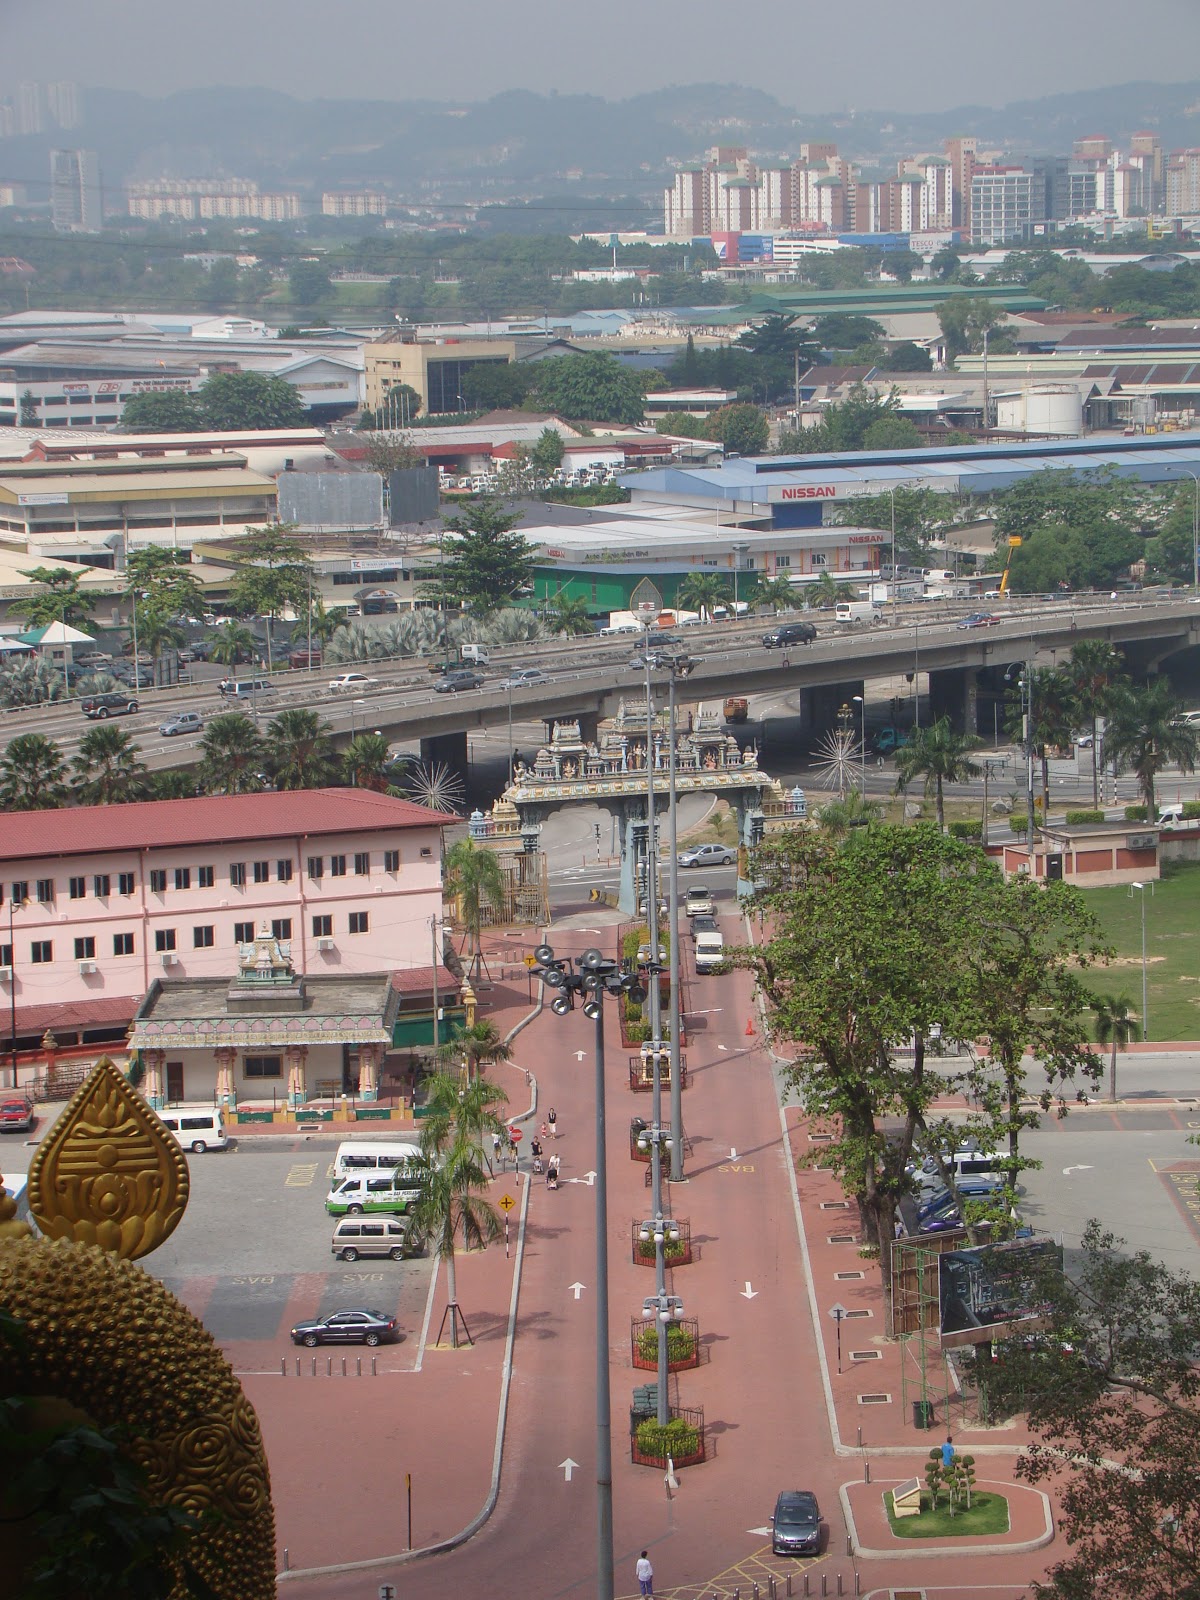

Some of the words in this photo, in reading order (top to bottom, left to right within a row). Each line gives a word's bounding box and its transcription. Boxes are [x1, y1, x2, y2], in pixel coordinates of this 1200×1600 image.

[782, 486, 836, 499] NISSAN
[848, 535, 884, 544] NISSAN
[547, 549, 565, 558] NISSAN
[718, 1165, 755, 1173] BAS
[231, 1275, 275, 1285] BAS
[342, 1273, 384, 1282] BAS
